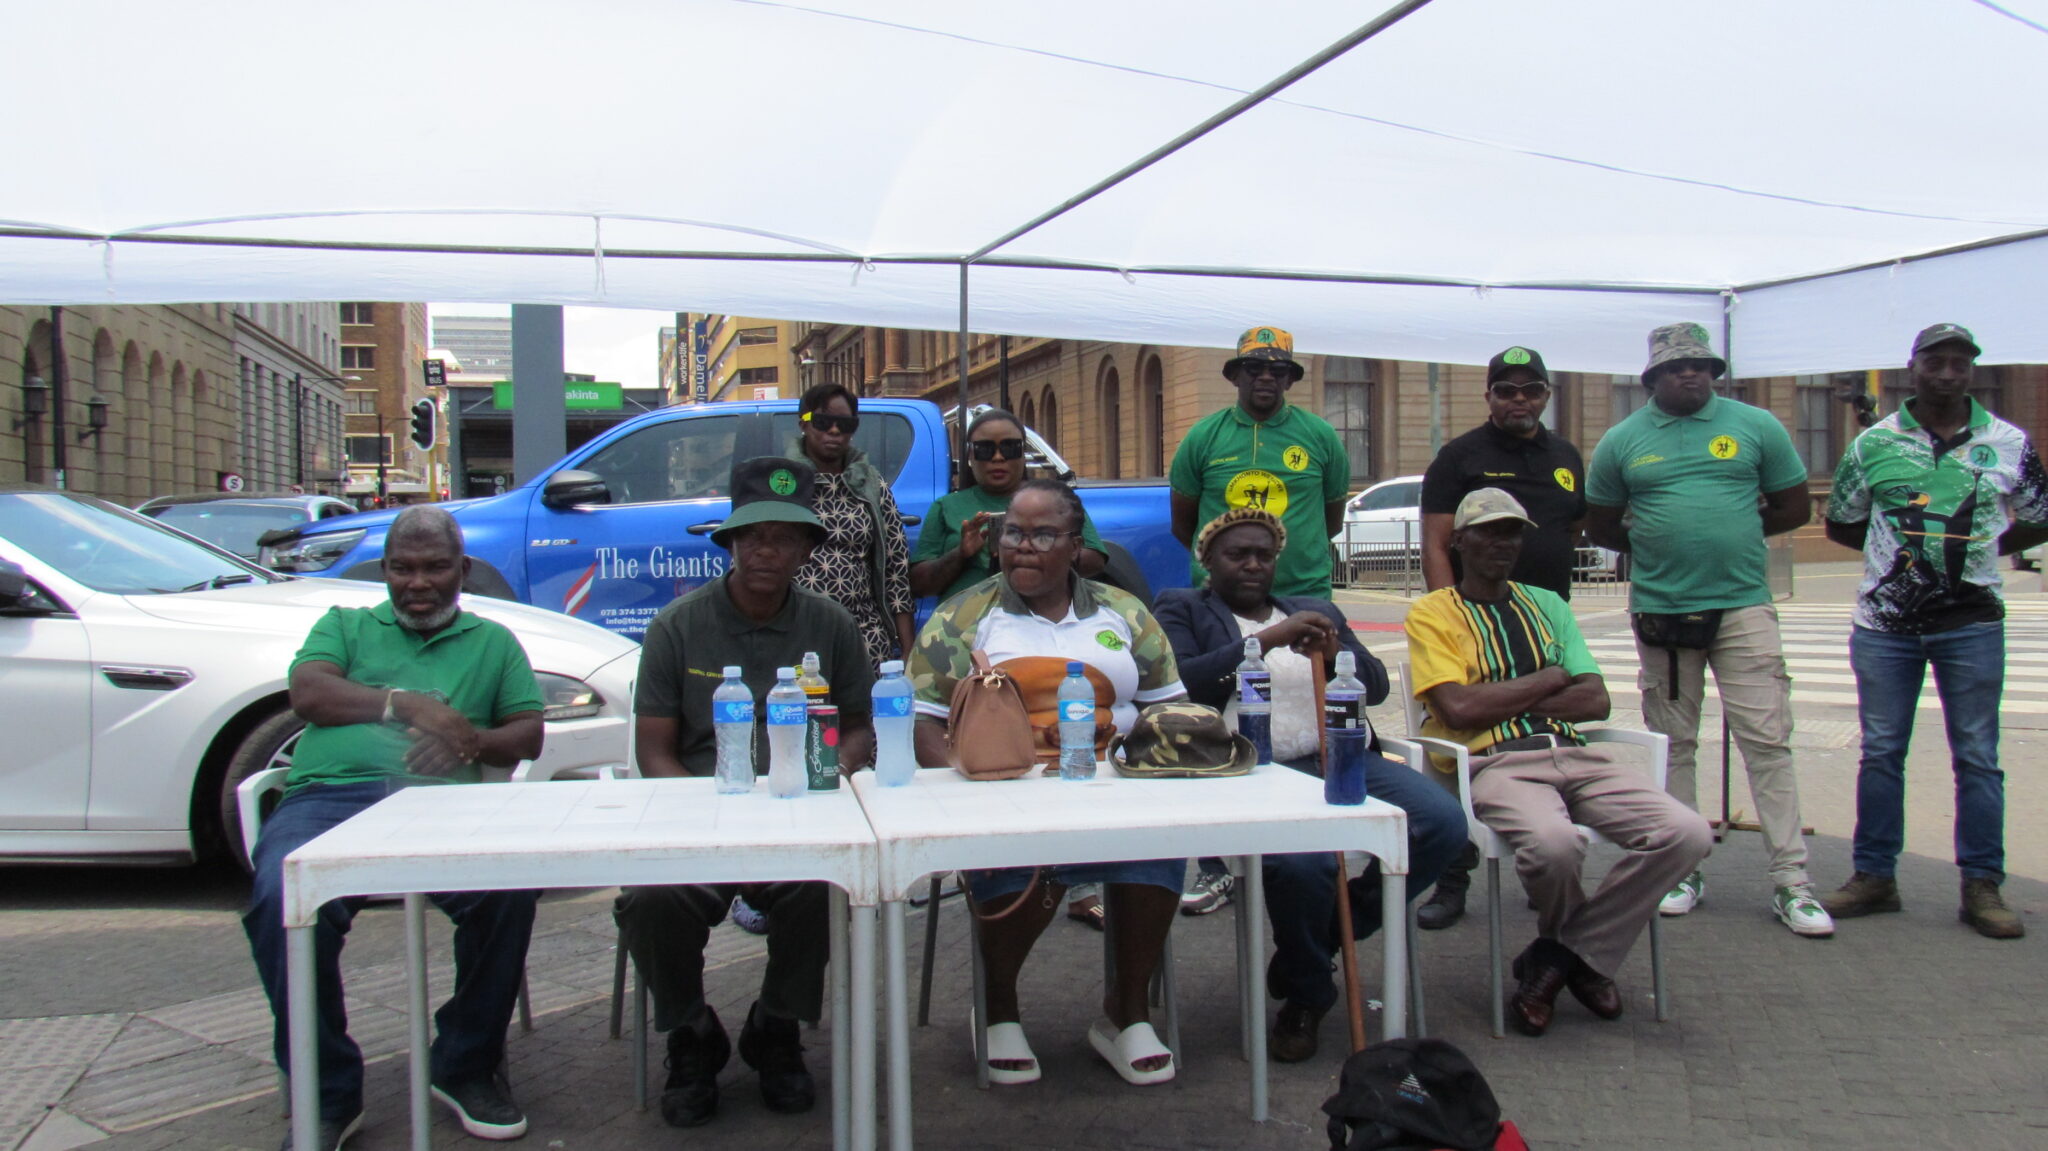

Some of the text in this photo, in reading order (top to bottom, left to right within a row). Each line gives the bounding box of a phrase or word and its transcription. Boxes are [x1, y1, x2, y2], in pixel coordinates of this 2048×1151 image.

[678, 342, 688, 385] workerslife
[696, 354, 708, 401] Dameli
[565, 389, 599, 400] akinta
[596, 546, 724, 579] The Giants
[605, 617, 652, 625] info@thegi
[810, 719, 823, 773] Grapetiser
